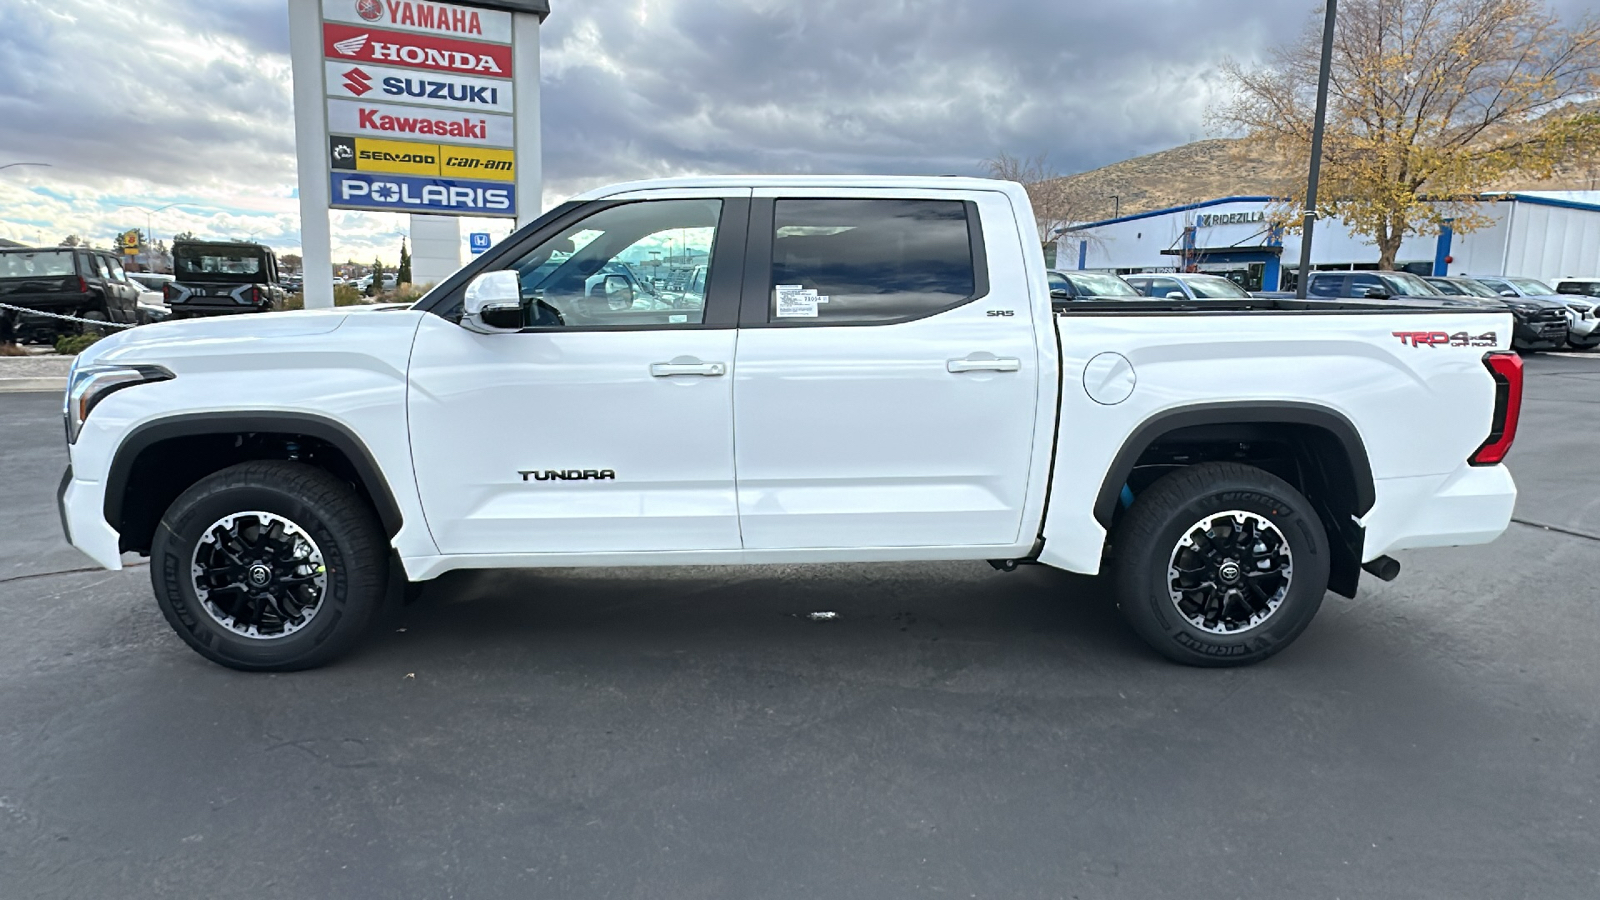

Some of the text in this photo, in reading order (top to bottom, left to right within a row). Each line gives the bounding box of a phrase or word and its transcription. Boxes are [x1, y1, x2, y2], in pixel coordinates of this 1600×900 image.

[386, 0, 482, 35] YAMAHA
[371, 41, 502, 73] HONDA
[382, 77, 498, 104] SUZUKI
[359, 108, 487, 139] Kawasaki
[446, 157, 513, 170] can-am
[341, 179, 510, 209] POLARIS
[1212, 211, 1265, 226] RIDEZILLA
[1391, 331, 1450, 348] TRD
[517, 469, 615, 481] TUNDRA
